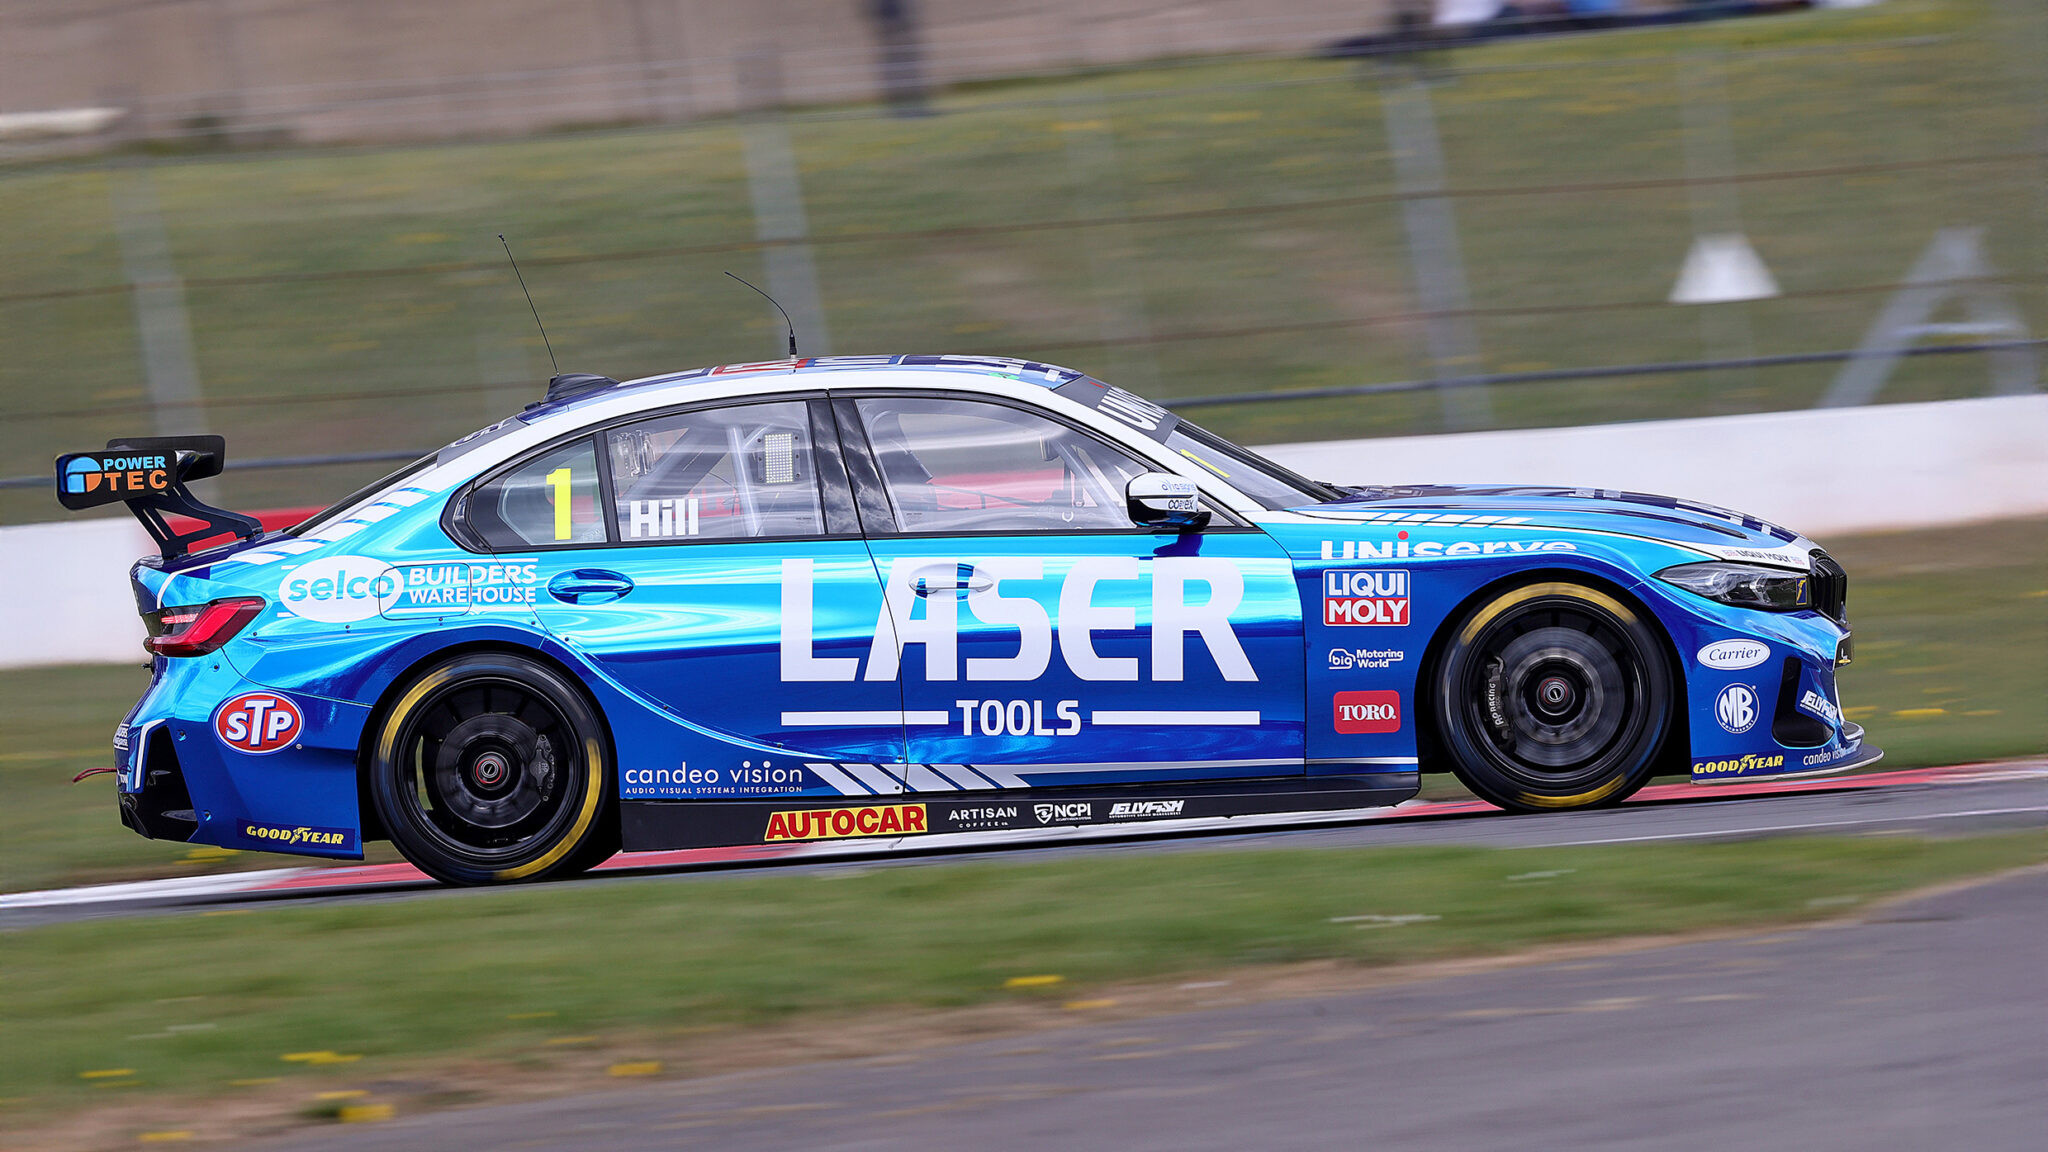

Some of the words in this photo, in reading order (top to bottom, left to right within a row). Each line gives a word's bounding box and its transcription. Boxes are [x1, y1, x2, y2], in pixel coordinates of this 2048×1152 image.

[103, 455, 166, 471] POWER
[104, 469, 168, 492] TEC
[546, 467, 572, 541] 1
[630, 498, 699, 538] Hill
[287, 569, 396, 601] selco
[408, 564, 538, 587] BUILDERS
[1328, 572, 1405, 598] LIQUI
[408, 586, 537, 604] WAREHOUSE
[780, 557, 1260, 682] LASER
[1328, 599, 1408, 624] MOLY
[1332, 655, 1353, 670] big
[1356, 649, 1404, 662] Motoring
[1357, 659, 1390, 668] World
[1708, 647, 1761, 661] Carrier
[1339, 703, 1395, 721] TORO
[1719, 686, 1754, 728] MB
[225, 698, 294, 747] STP
[955, 700, 1082, 737] TOOLS
[1693, 754, 1785, 774] GOODYEAR
[1803, 747, 1832, 766] candeo
[625, 761, 719, 784] candeo
[730, 760, 803, 784] vision
[696, 786, 736, 794] SYSTEMS
[739, 785, 803, 793] INTEGRATION
[948, 807, 1018, 820] ARTISAN
[1054, 803, 1091, 817] NCPI
[1108, 800, 1185, 815] JELLYFISH
[766, 806, 925, 840] AUTOCAR
[246, 824, 345, 845] GOODYEAR
